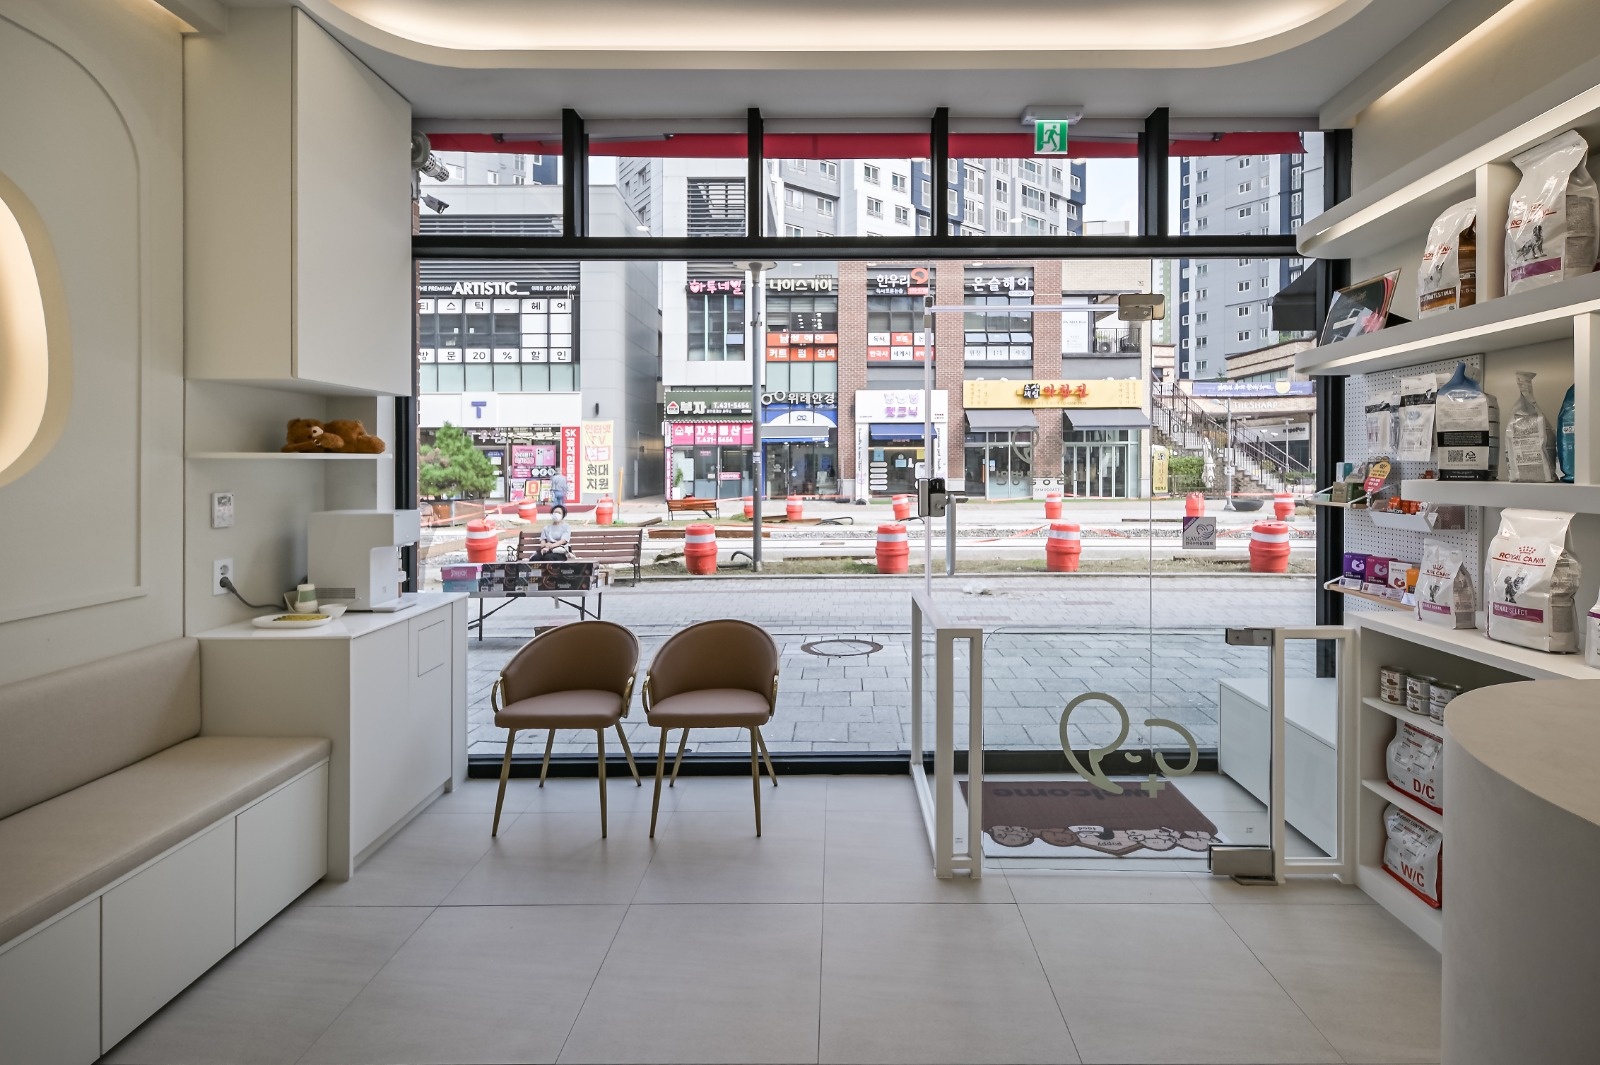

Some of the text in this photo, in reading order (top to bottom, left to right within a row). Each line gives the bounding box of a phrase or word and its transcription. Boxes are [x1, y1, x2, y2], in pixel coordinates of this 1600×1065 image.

[769, 278, 833, 292] 나이스가이
[876, 274, 911, 288] 한우리
[972, 276, 1029, 291] 온슬헤어
[531, 351, 567, 362] 할인
[769, 348, 788, 358] 커트
[797, 348, 807, 358] 펌
[817, 348, 835, 358] 염색
[788, 392, 835, 405] 위례안경
[471, 401, 487, 418] T
[680, 401, 707, 415] 부자
[564, 429, 577, 437] SK
[684, 425, 741, 436] 부자부동산
[590, 435, 606, 445] TV
[586, 464, 609, 476] 최대
[586, 478, 609, 490] 지원
[1498, 552, 1546, 564] ROYAL CANIN
[1508, 607, 1528, 616] SELECT
[1412, 778, 1436, 801] D/C
[1400, 860, 1425, 888] W/C
